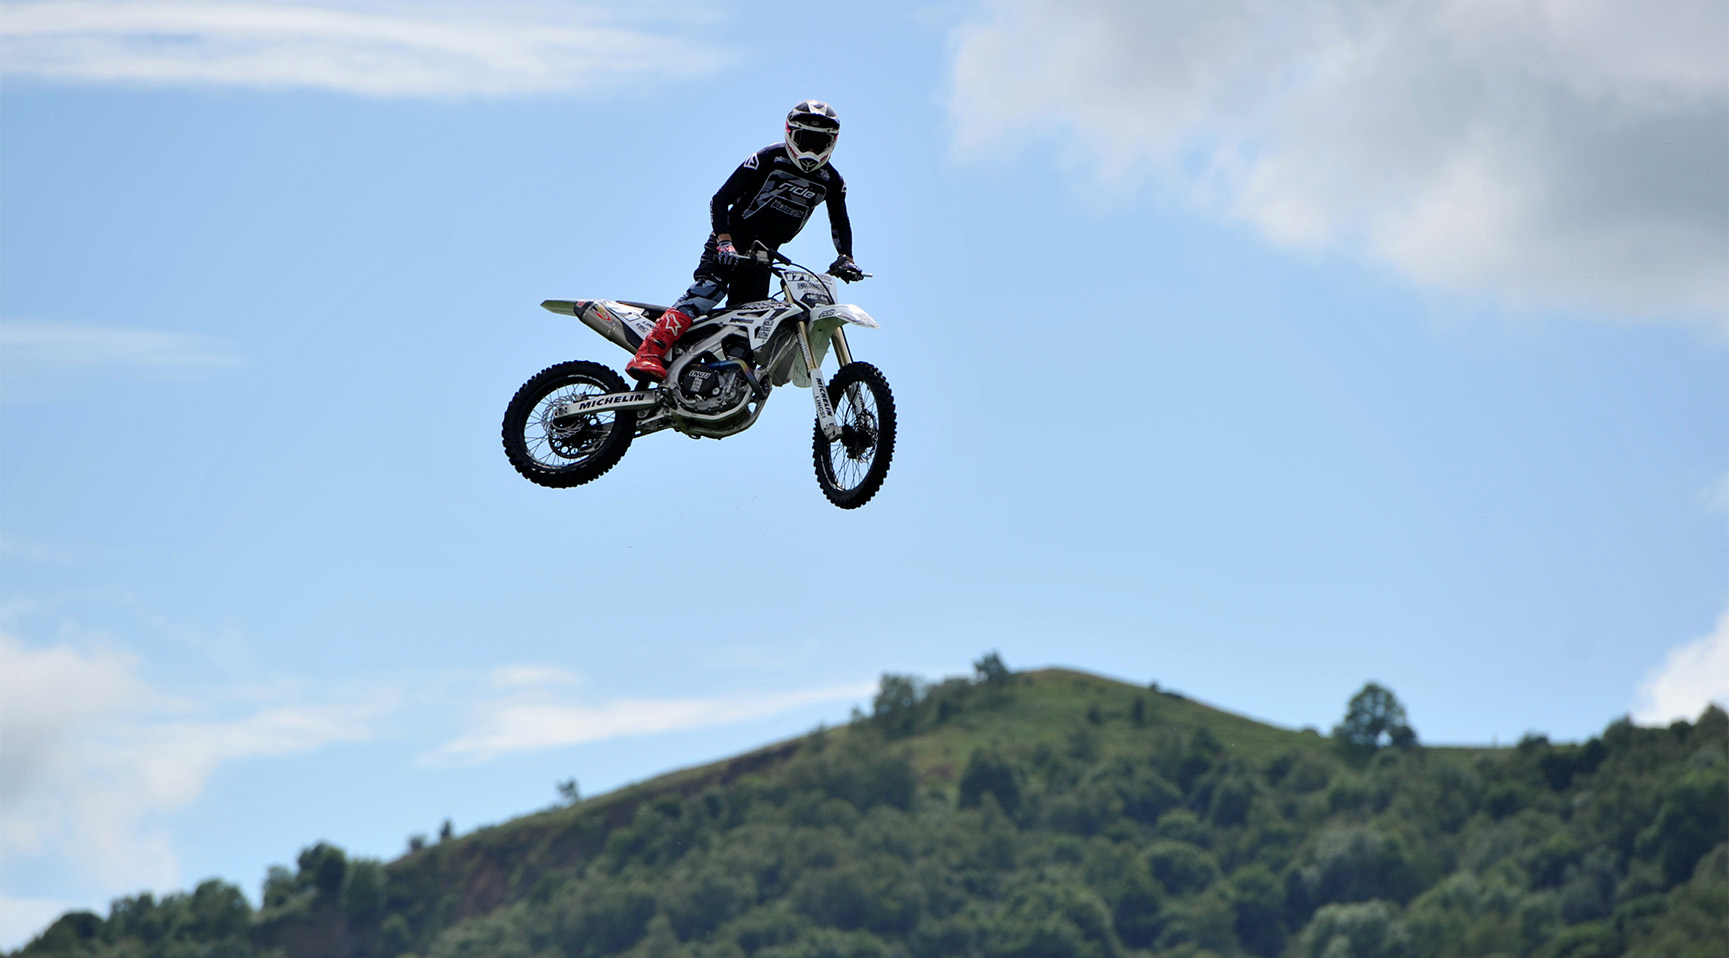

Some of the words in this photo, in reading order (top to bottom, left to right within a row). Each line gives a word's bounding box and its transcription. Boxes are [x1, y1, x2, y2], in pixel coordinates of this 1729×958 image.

[778, 182, 816, 199] ride
[579, 394, 645, 410] MICHELIN
[816, 377, 833, 416] MICHELIN
